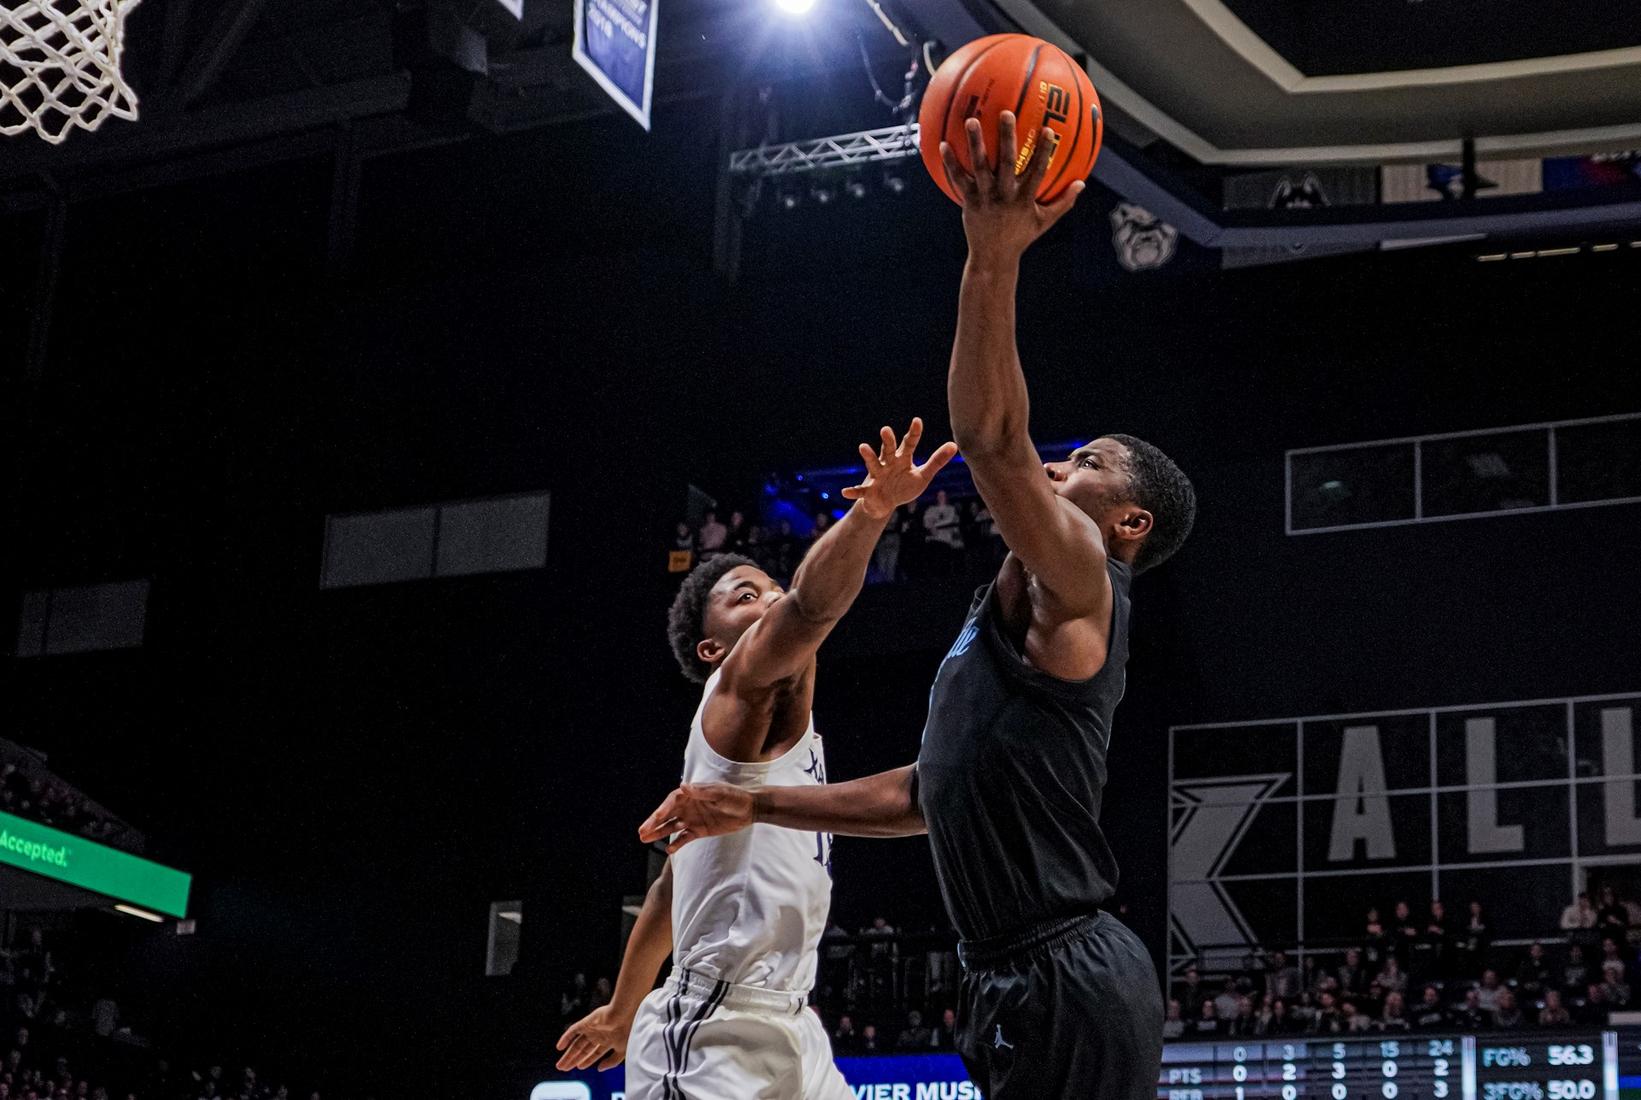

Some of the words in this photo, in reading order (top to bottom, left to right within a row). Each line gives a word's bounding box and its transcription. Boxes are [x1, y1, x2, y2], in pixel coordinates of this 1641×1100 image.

[1233, 1047, 1247, 1062] 0
[1282, 1045, 1296, 1061] 3
[1332, 1043, 1346, 1059] 5
[1380, 1041, 1400, 1058] 15
[1428, 1040, 1454, 1056] 24
[1483, 1047, 1531, 1067] FG%
[1548, 1045, 1594, 1066] 56.3
[1169, 1068, 1201, 1084] PTS
[1233, 1065, 1247, 1082] 0
[1282, 1063, 1296, 1081] 2
[1332, 1062, 1346, 1079] 3
[1382, 1060, 1398, 1078] 0
[1433, 1058, 1449, 1076] 2
[849, 1083, 911, 1100] VIER
[1235, 1086, 1244, 1100] 1
[1282, 1084, 1296, 1100] 0
[1332, 1082, 1347, 1100] 0
[1382, 1081, 1398, 1099] 0
[1433, 1079, 1449, 1098] 3
[1483, 1081, 1544, 1100] 3FG%
[1547, 1080, 1596, 1100] 50.0
